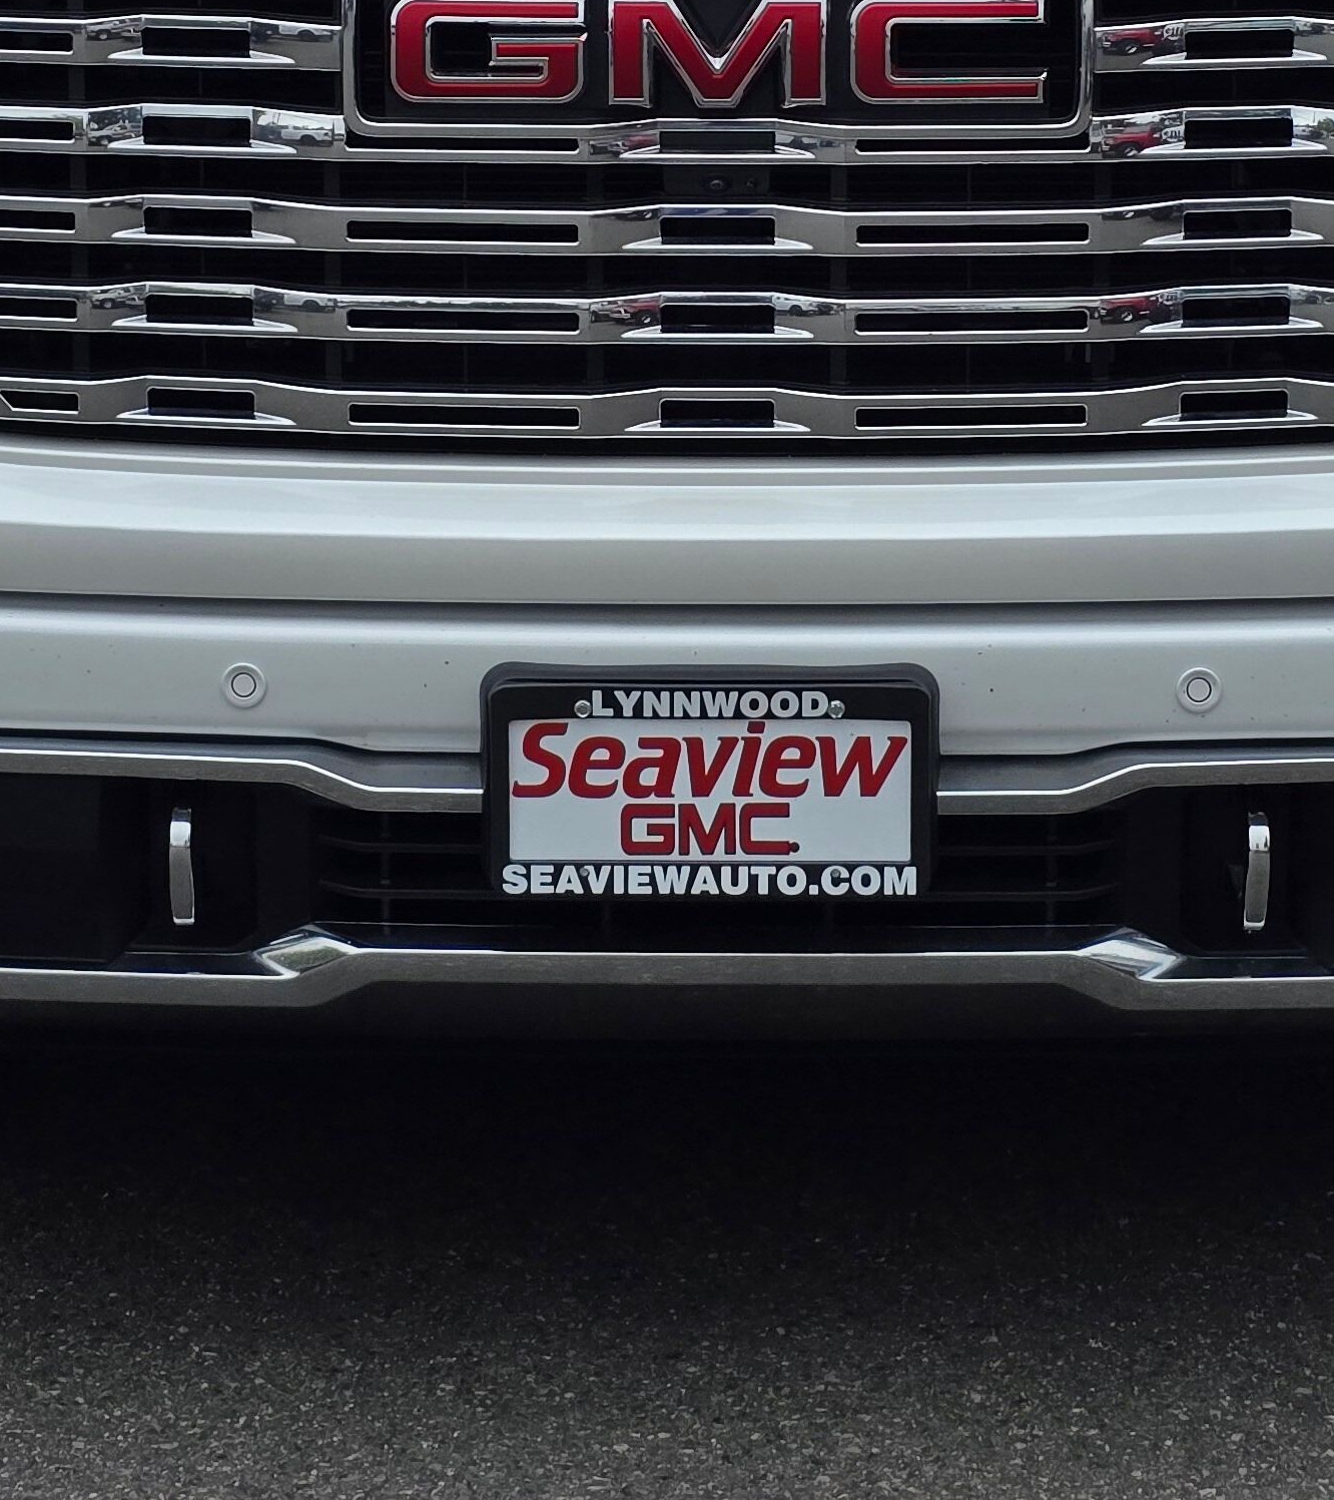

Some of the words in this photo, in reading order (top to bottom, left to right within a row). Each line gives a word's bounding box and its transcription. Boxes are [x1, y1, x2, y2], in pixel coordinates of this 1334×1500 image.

[592, 690, 829, 718] LYNNWOOD
[512, 720, 908, 799] Seaview
[620, 802, 793, 856] GMC
[501, 864, 918, 896] SEAVIEWAUTO.COM
